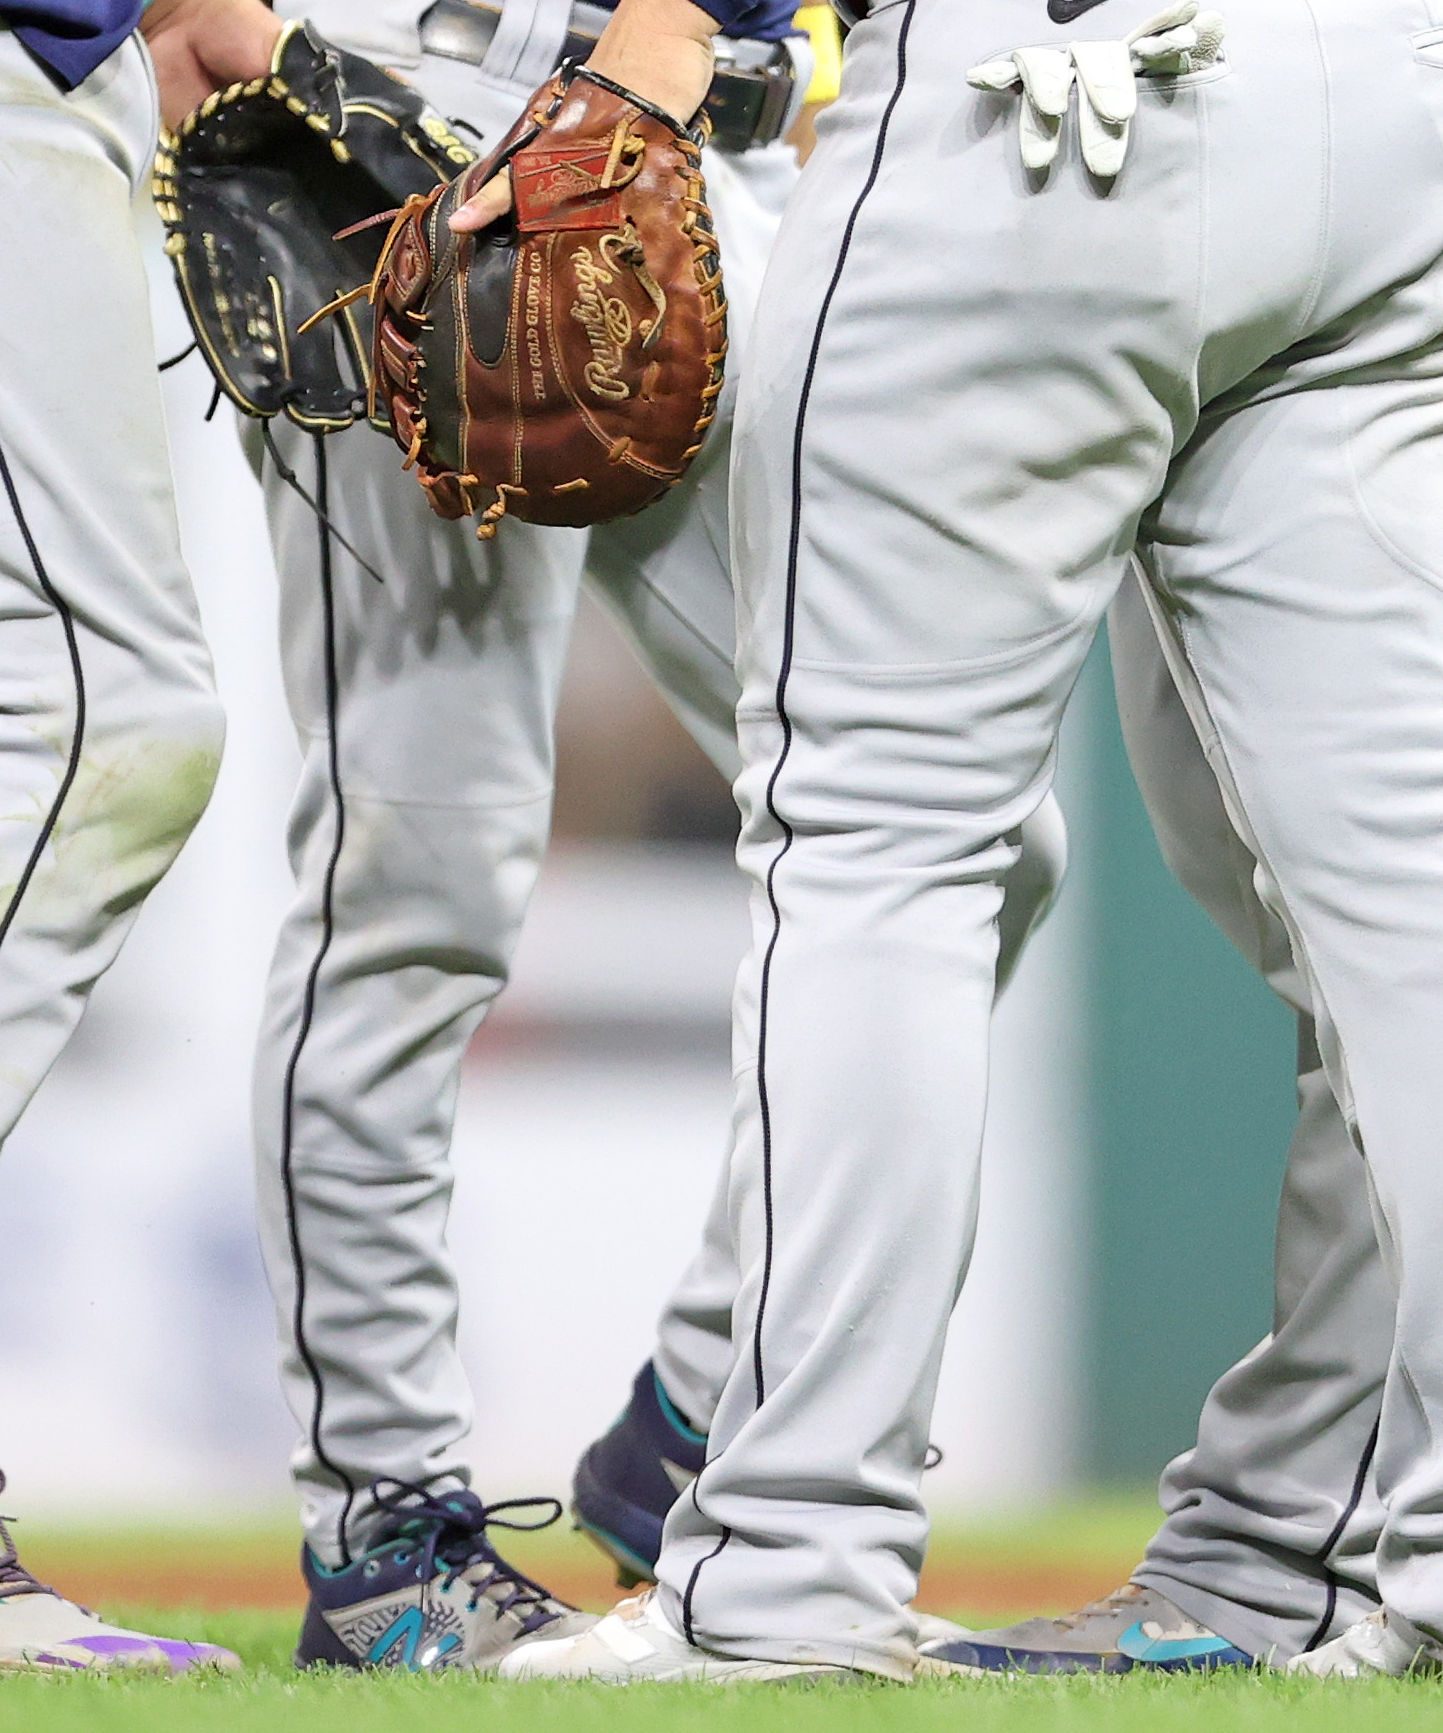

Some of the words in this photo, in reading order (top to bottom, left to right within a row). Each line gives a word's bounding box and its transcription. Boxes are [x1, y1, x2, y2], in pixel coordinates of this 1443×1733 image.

[529, 250, 542, 274] CO
[526, 275, 542, 326] GLOVE
[569, 245, 633, 401] Rawlings
[526, 327, 542, 368] GOLD
[531, 370, 547, 400] THE
